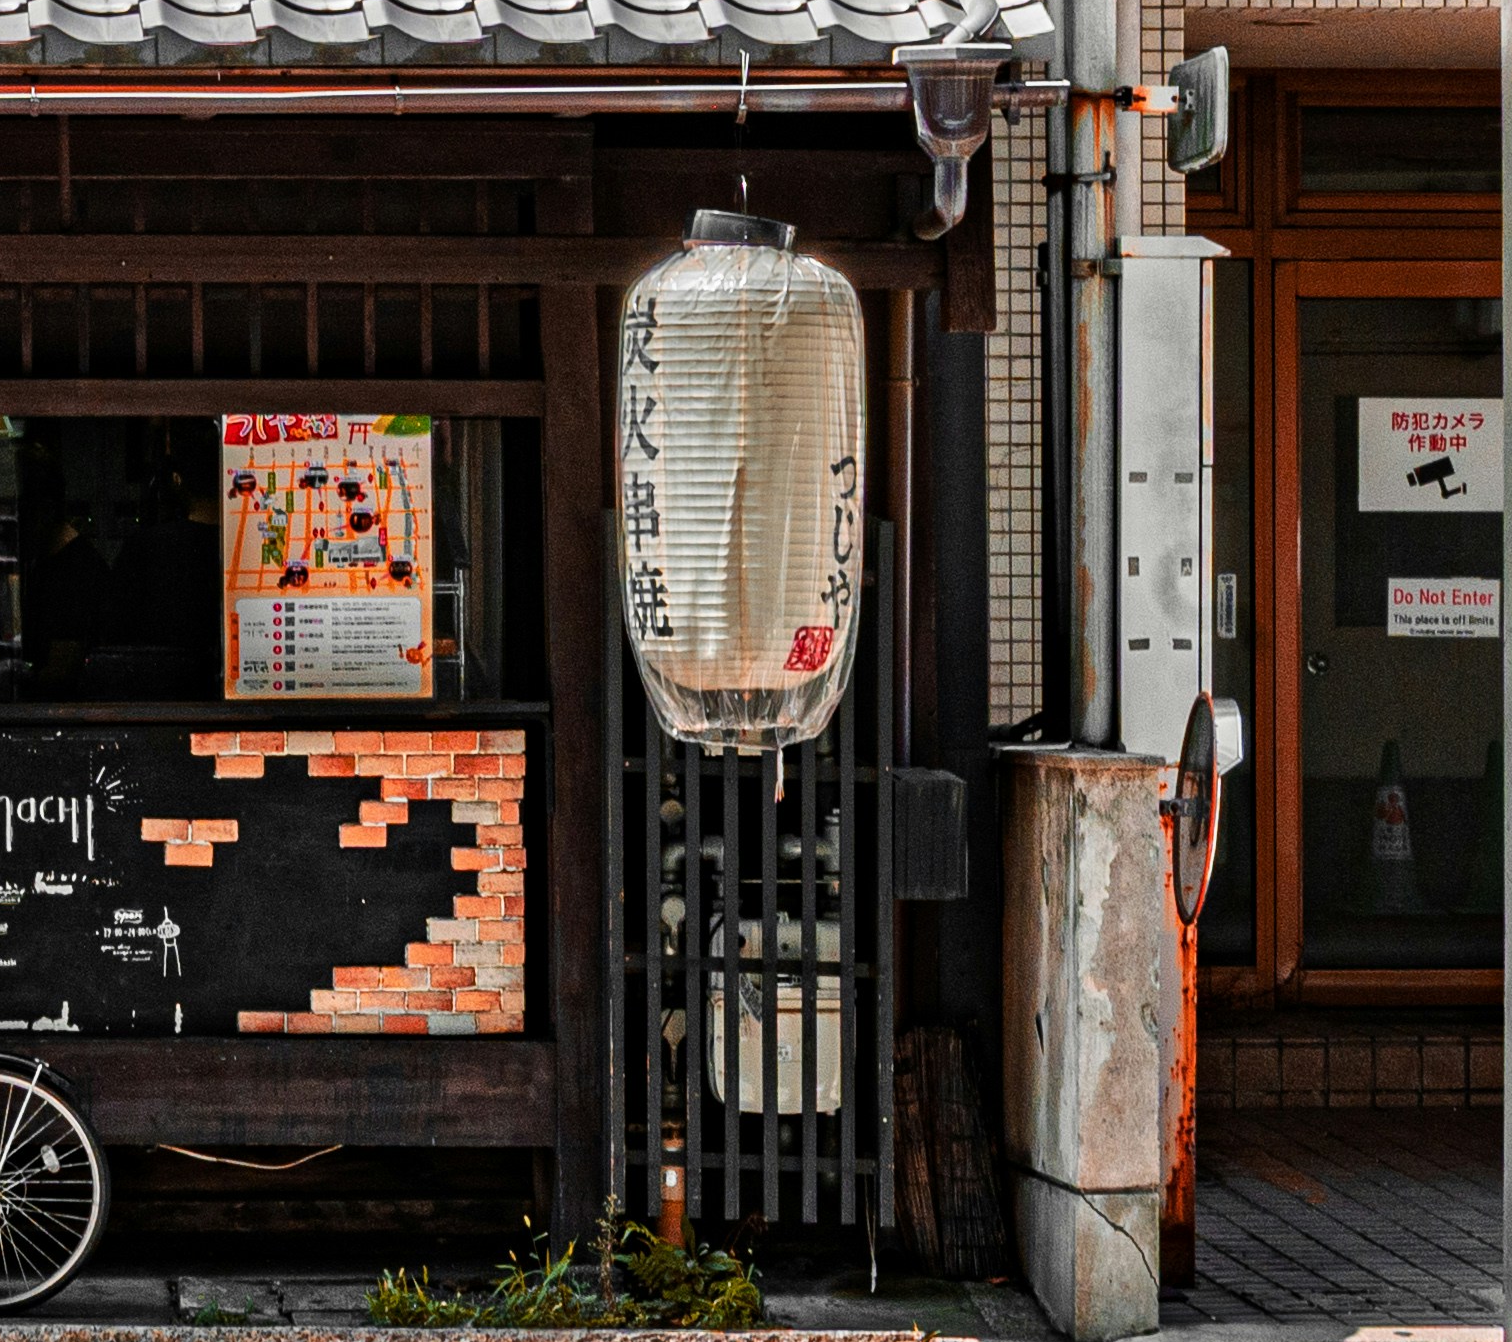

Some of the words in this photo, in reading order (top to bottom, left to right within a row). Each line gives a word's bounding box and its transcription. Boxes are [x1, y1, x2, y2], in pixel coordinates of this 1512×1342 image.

[1392, 412, 1485, 431] 防犯カメラ
[1408, 434, 1467, 452] 作動中
[820, 455, 857, 630] つじや
[1394, 589, 1413, 605] Do
[1420, 589, 1446, 605] Not
[1452, 589, 1493, 605] Enter
[1394, 614, 1412, 624] This
[1415, 615, 1440, 626] place
